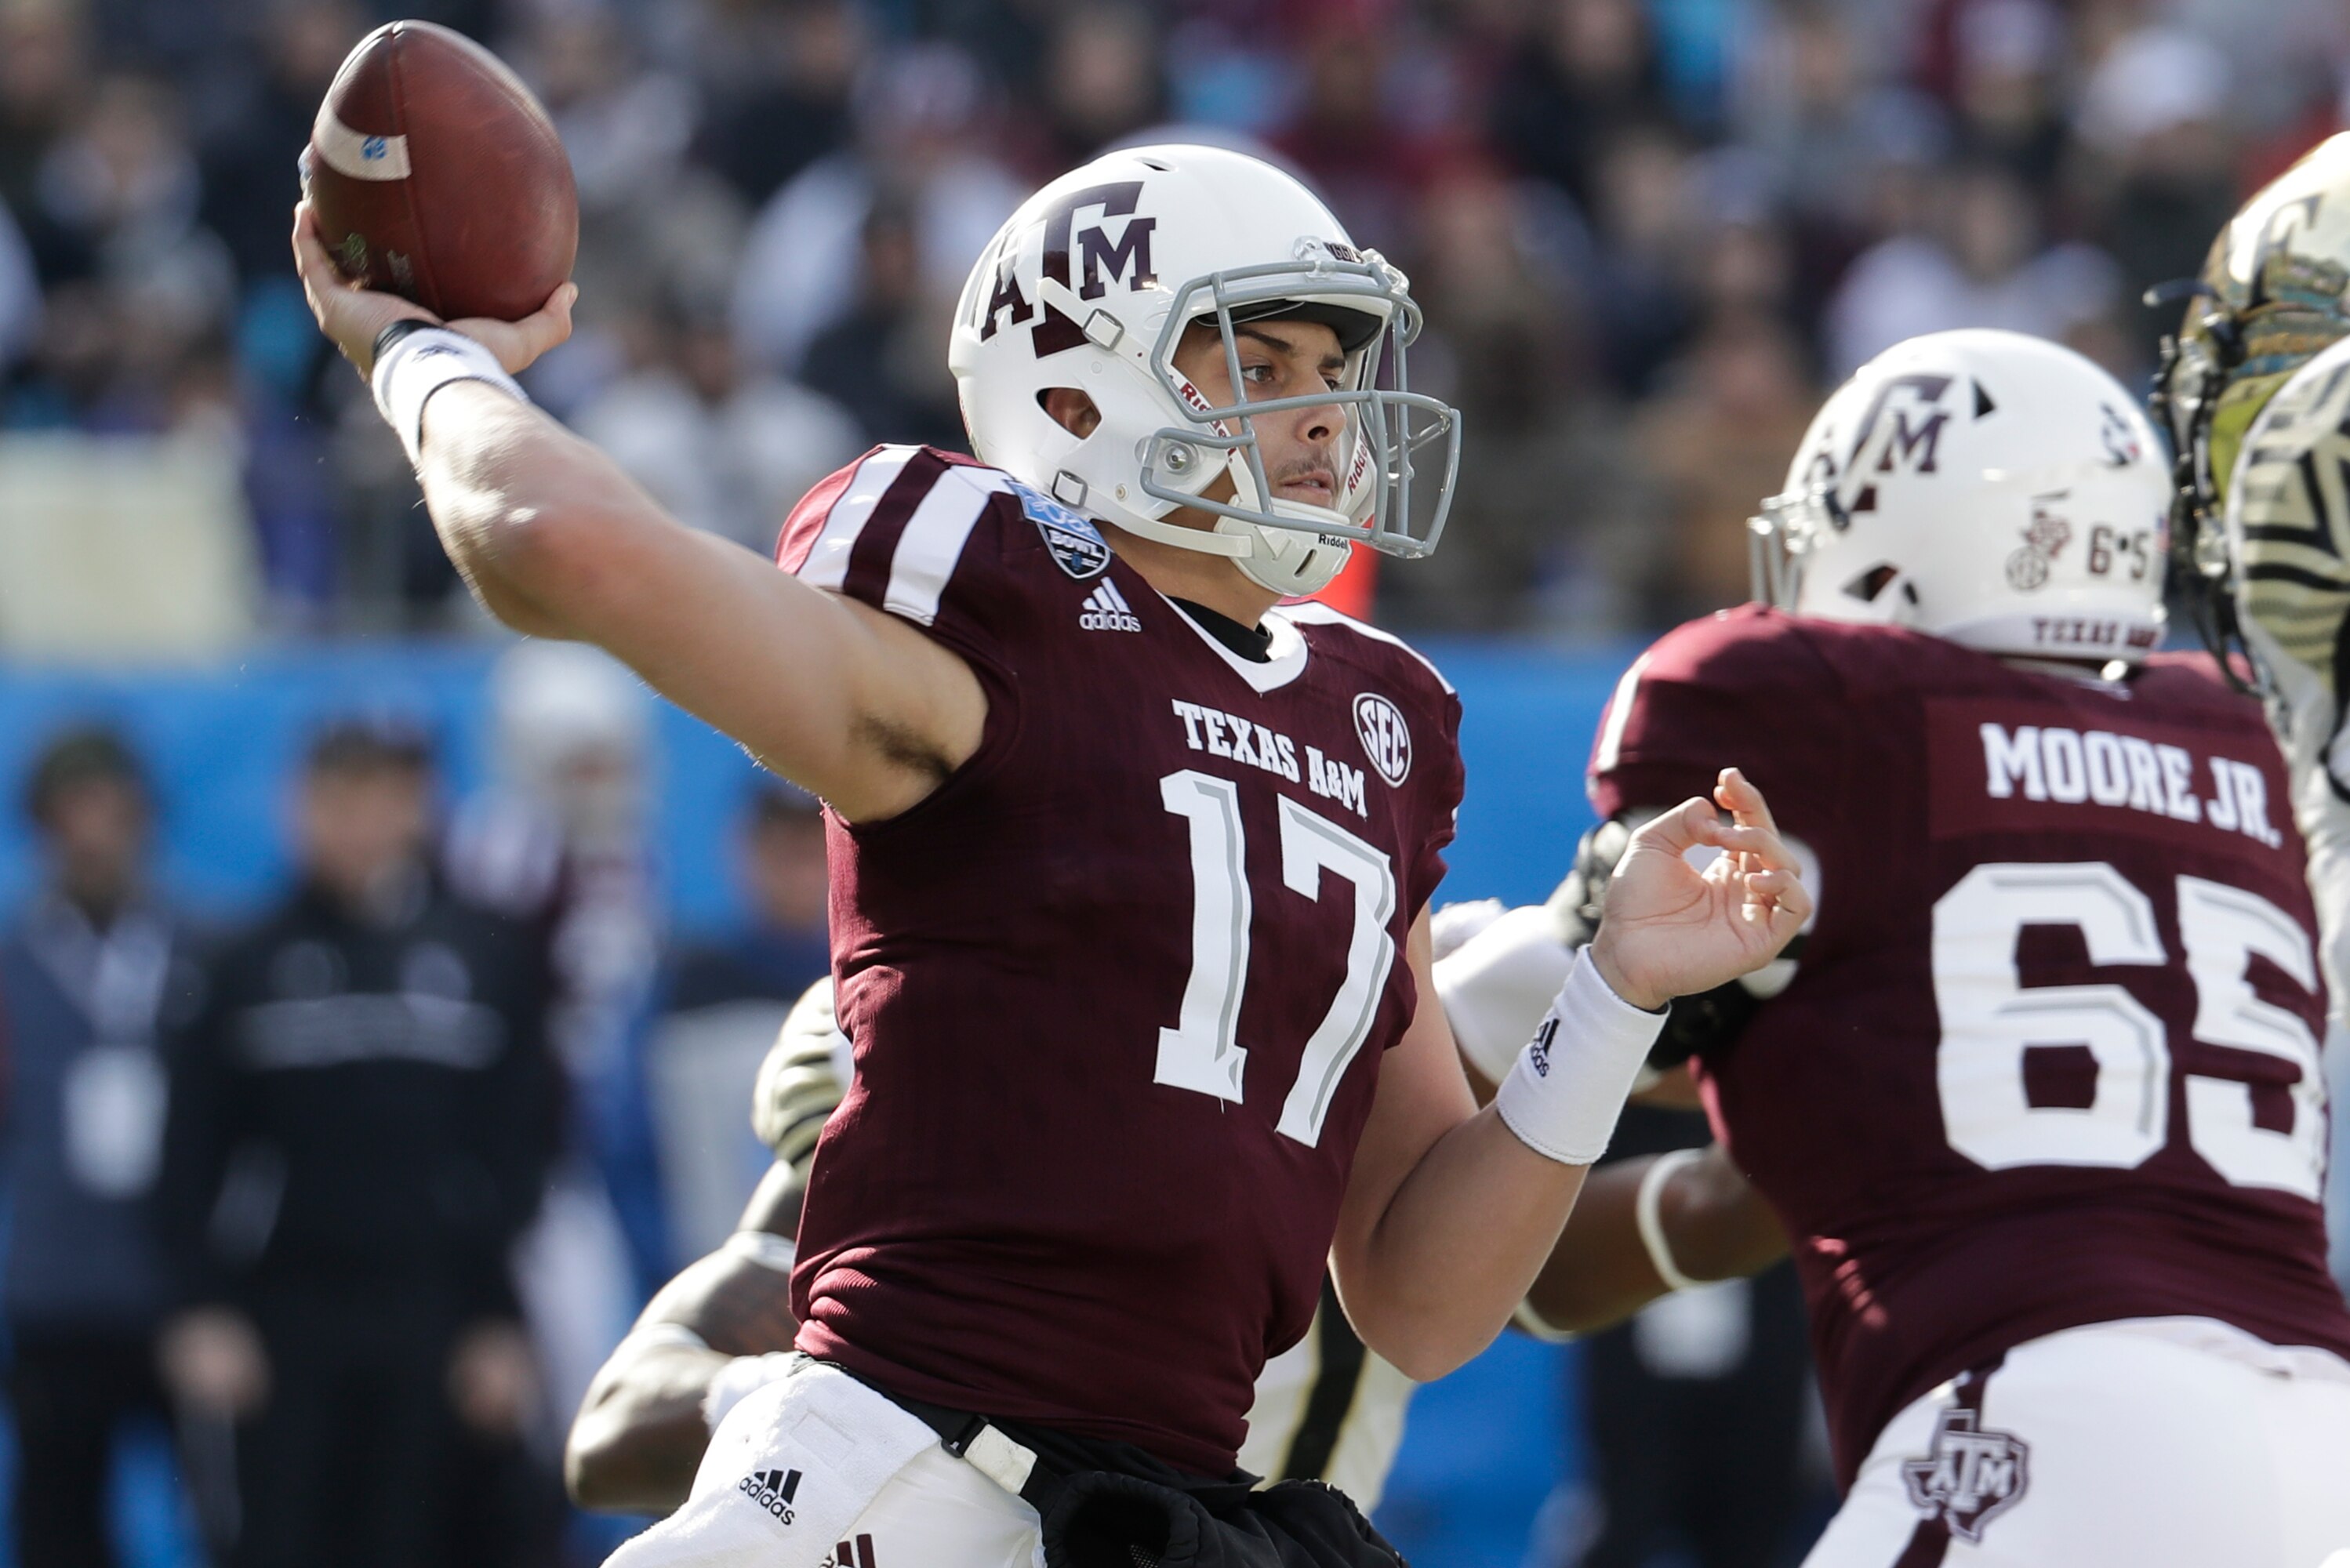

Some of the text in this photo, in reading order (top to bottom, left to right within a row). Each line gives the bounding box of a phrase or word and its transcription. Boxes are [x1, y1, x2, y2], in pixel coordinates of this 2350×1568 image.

[980, 180, 1158, 359] ATM
[1318, 533, 1349, 550] Riddell
[1079, 608, 1142, 633] adidas
[1171, 698, 1368, 819] TEXAS A&M
[1360, 699, 1406, 779] SEC
[1978, 722, 2283, 850] MOORE JR.
[1153, 768, 1397, 1149] 17
[1930, 861, 2323, 1204] 65
[739, 1476, 795, 1526] adidas
